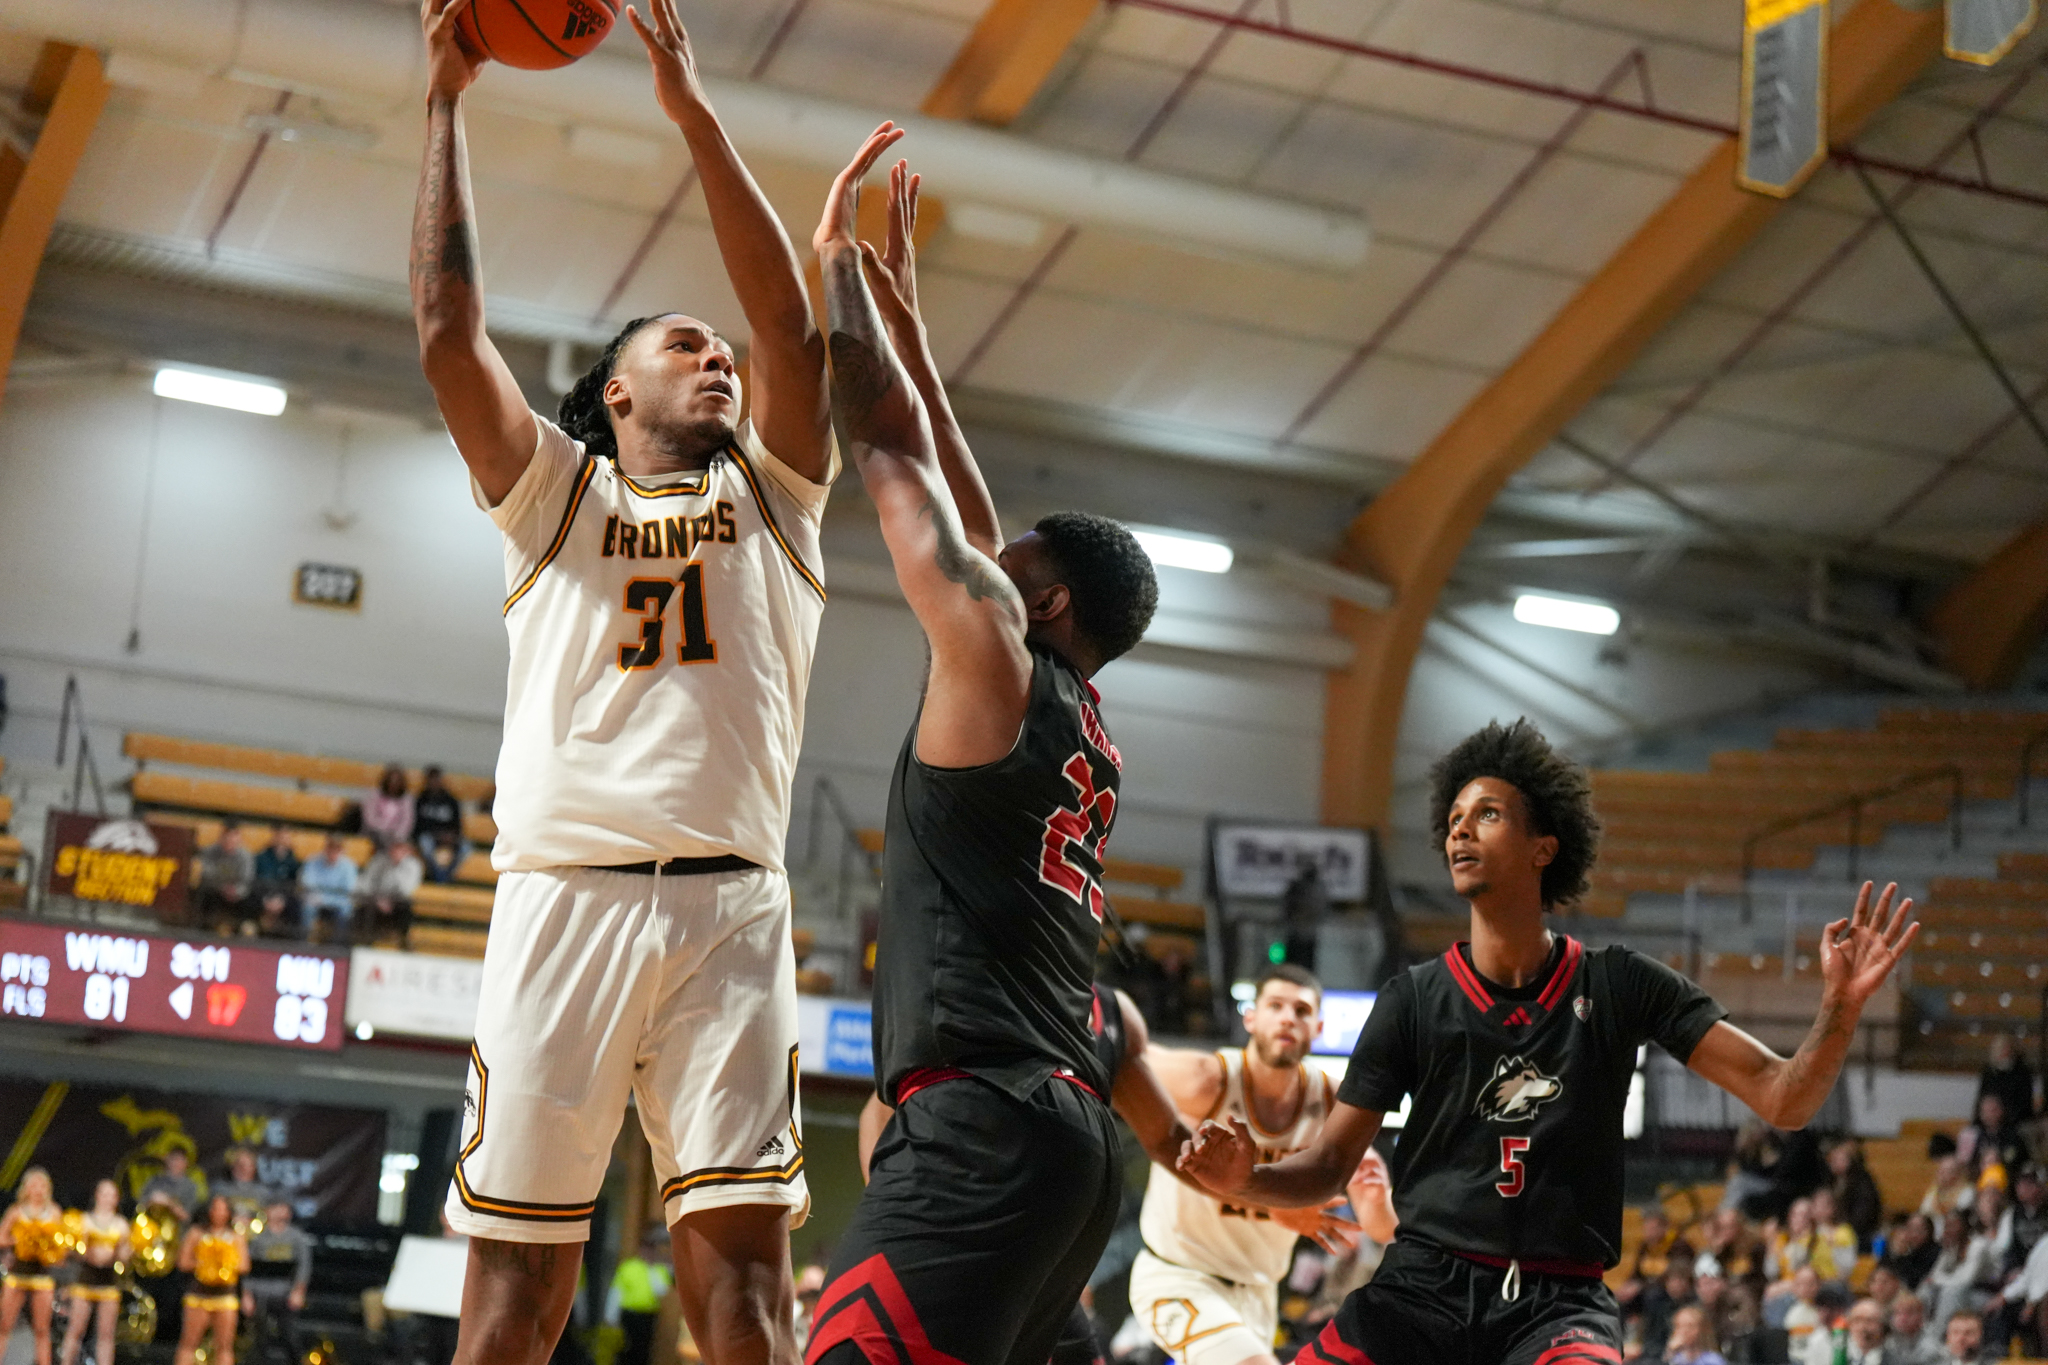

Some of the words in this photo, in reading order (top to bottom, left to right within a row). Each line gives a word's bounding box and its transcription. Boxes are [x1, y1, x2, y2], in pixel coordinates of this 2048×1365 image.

[616, 560, 718, 674] 31
[65, 931, 150, 979] WMU
[227, 1113, 287, 1148] WE
[256, 1153, 316, 1187] UST
[756, 1148, 785, 1157] adida
[1495, 1136, 1531, 1198] 5
